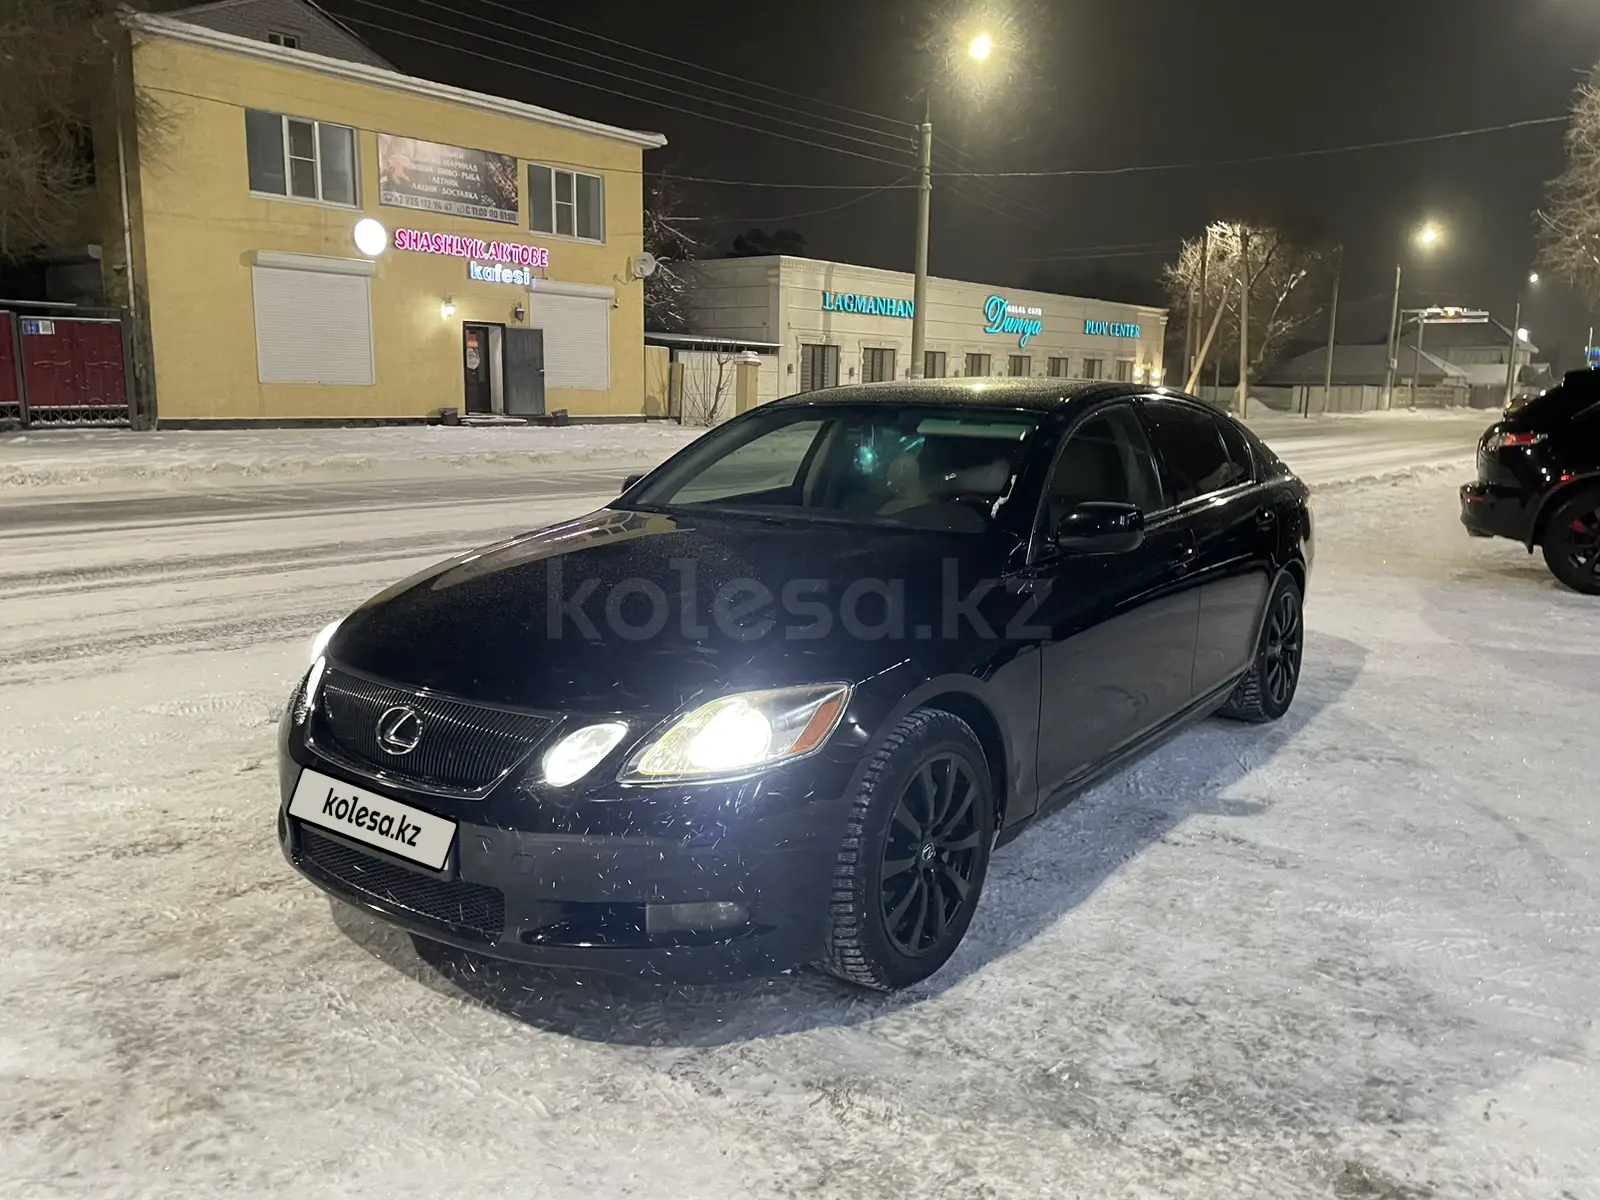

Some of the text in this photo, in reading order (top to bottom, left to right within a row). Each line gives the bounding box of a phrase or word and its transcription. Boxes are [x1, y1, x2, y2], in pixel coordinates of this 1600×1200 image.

[437, 168, 458, 178] ПИВО
[441, 188, 479, 200] ДОСТАВКА
[470, 261, 531, 285] kafesi
[985, 295, 1042, 348] Dunya
[1085, 319, 1140, 338] PLOV CENTER
